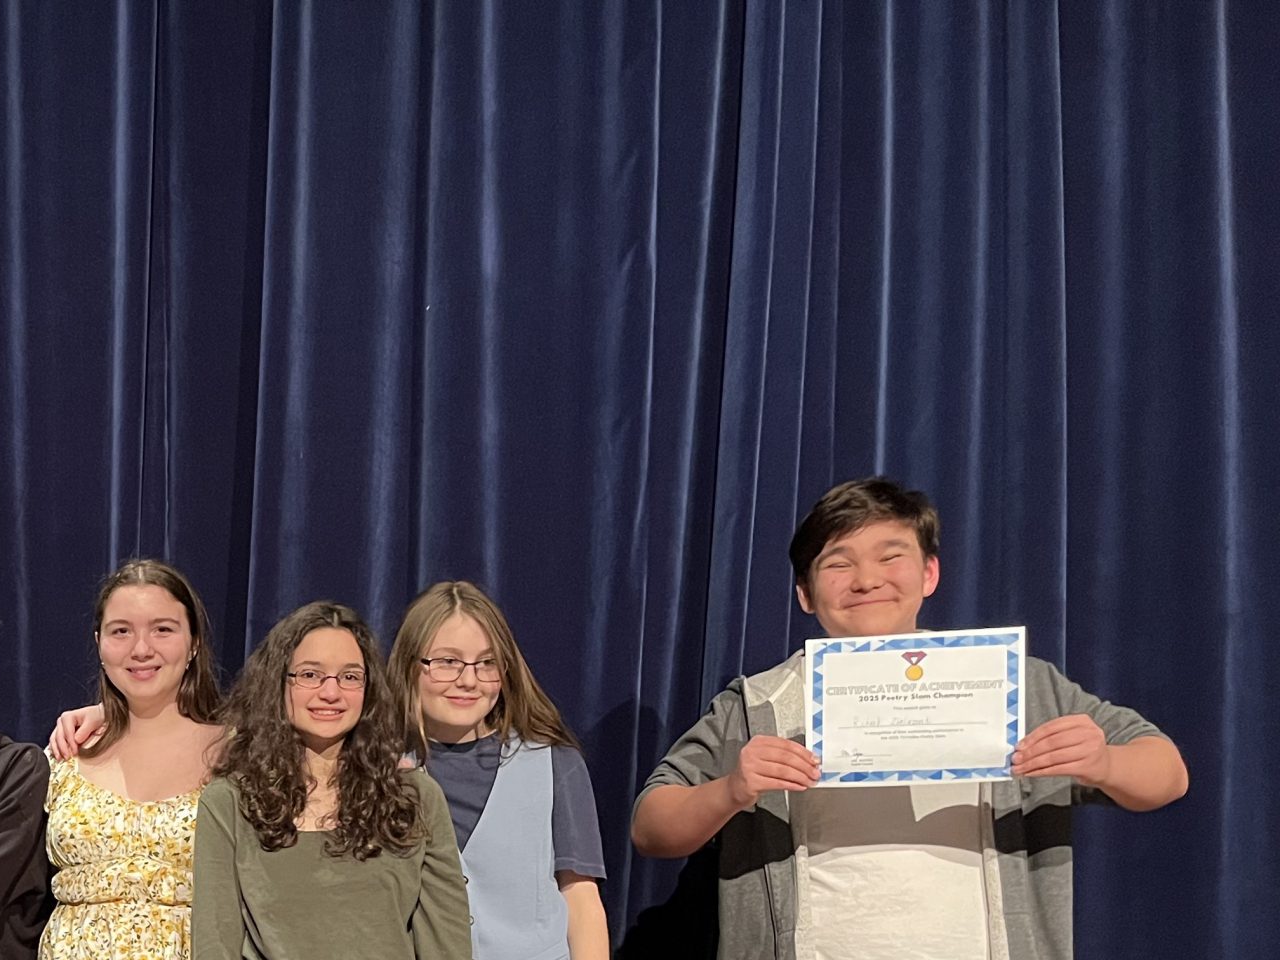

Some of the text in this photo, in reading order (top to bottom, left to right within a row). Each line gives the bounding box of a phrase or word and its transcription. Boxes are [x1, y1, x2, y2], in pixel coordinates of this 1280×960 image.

[825, 679, 1004, 696] CERTIFICATE OF ACHIEVEMENT
[881, 693, 908, 701] Poetry
[910, 692, 931, 700] Slam
[933, 691, 973, 700] Champion
